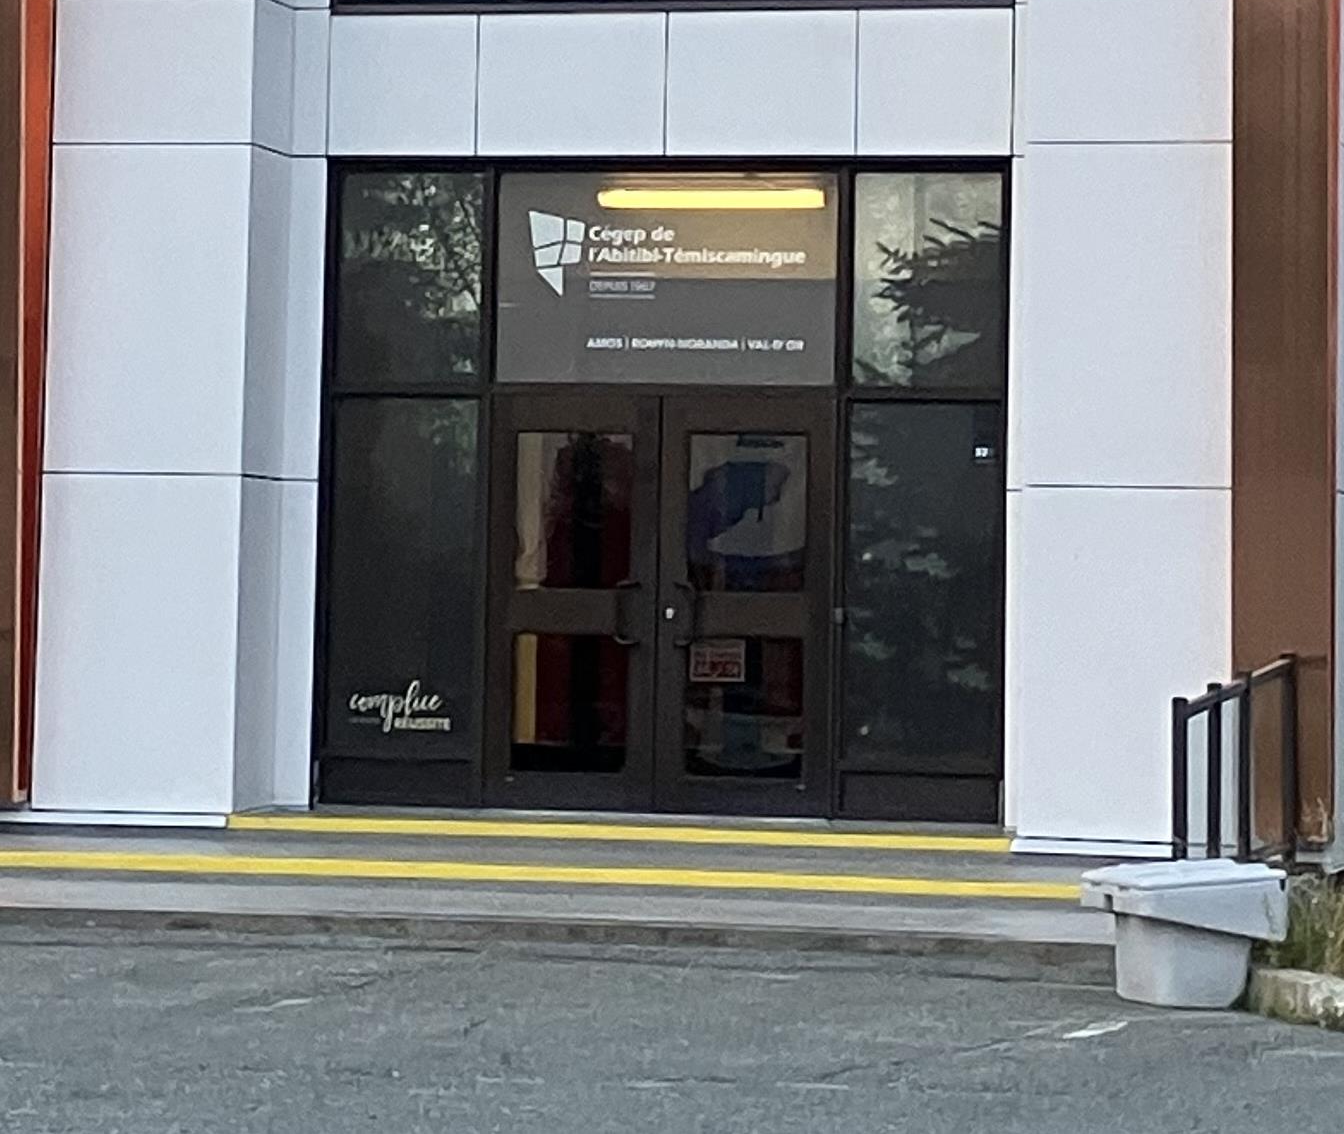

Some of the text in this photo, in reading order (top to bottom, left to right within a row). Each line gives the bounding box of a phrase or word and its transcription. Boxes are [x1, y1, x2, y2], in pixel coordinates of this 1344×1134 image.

[589, 225, 675, 245] Cégep de
[588, 247, 806, 268] l'Abitibi-Témiscamingue
